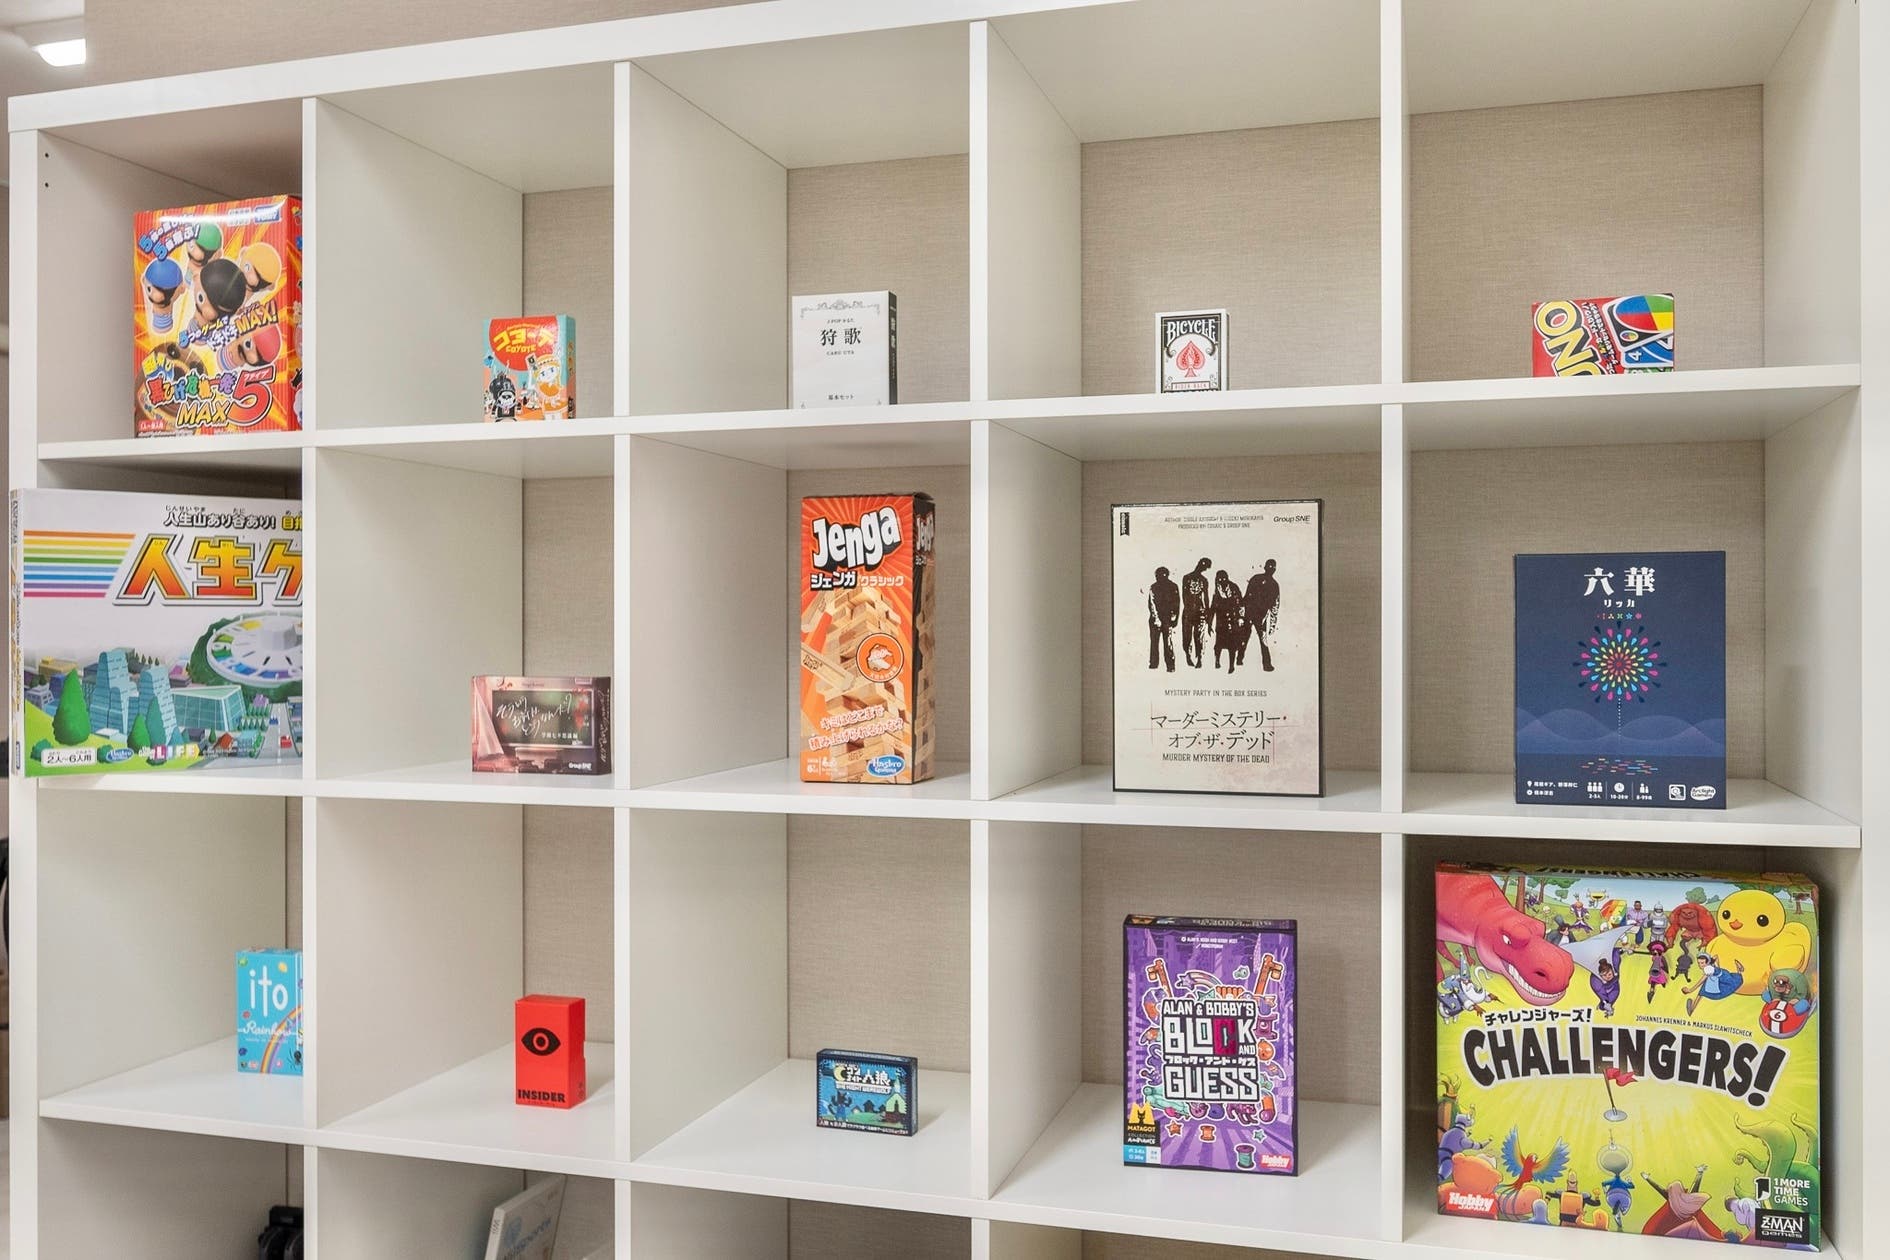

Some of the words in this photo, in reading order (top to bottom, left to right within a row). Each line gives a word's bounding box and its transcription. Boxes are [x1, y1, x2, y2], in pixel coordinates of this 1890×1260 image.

[493, 327, 555, 352] コヨーテ
[820, 327, 862, 346] 狩歌
[1166, 318, 1217, 347] BICYCLE
[505, 344, 537, 353] COYOTE
[177, 401, 230, 427] MAX
[1273, 515, 1294, 523] Group
[812, 505, 902, 570] Jenga
[811, 571, 857, 590] ジェンガ
[859, 575, 904, 587] クラシック
[1584, 566, 1656, 596] 六華
[1603, 599, 1635, 608] リッカ
[1165, 689, 1191, 697] MYSTERY
[871, 757, 902, 768] Hasbro
[1162, 753, 1191, 762] MURDER
[1193, 753, 1224, 763] MYSTERY
[1226, 754, 1235, 763] OF
[1237, 754, 1250, 763] THE
[1251, 755, 1270, 763] DEAD
[249, 965, 289, 1018] ito
[1163, 1002, 1194, 1016] ALAN
[1195, 1003, 1203, 1015] &
[1206, 1002, 1254, 1017] BOBBY'S
[1485, 1008, 1592, 1027] チャレンジャーズ!
[1772, 1009, 1784, 1020] 6
[1636, 1014, 1662, 1024] JOHANNES
[1663, 1016, 1686, 1026] KRENNER
[1692, 1020, 1713, 1030] MARKUS
[1714, 1023, 1753, 1037] SLAWITSCHECK
[1164, 1016, 1255, 1056] BLOCK
[1238, 1046, 1256, 1056] AND
[1463, 1027, 1786, 1107] CHALLENGERS!
[1165, 1066, 1259, 1100] GUESS
[517, 1088, 566, 1103] INSIDER
[1127, 1124, 1156, 1133] MATAGOT
[1773, 1186, 1800, 1197] TIME
[1780, 1178, 1811, 1189] MORE
[1448, 1191, 1495, 1211] Hobby
[1774, 1195, 1809, 1206] GAMES
[1760, 1215, 1804, 1233] Z-MAN
[1761, 1230, 1803, 1239] games
